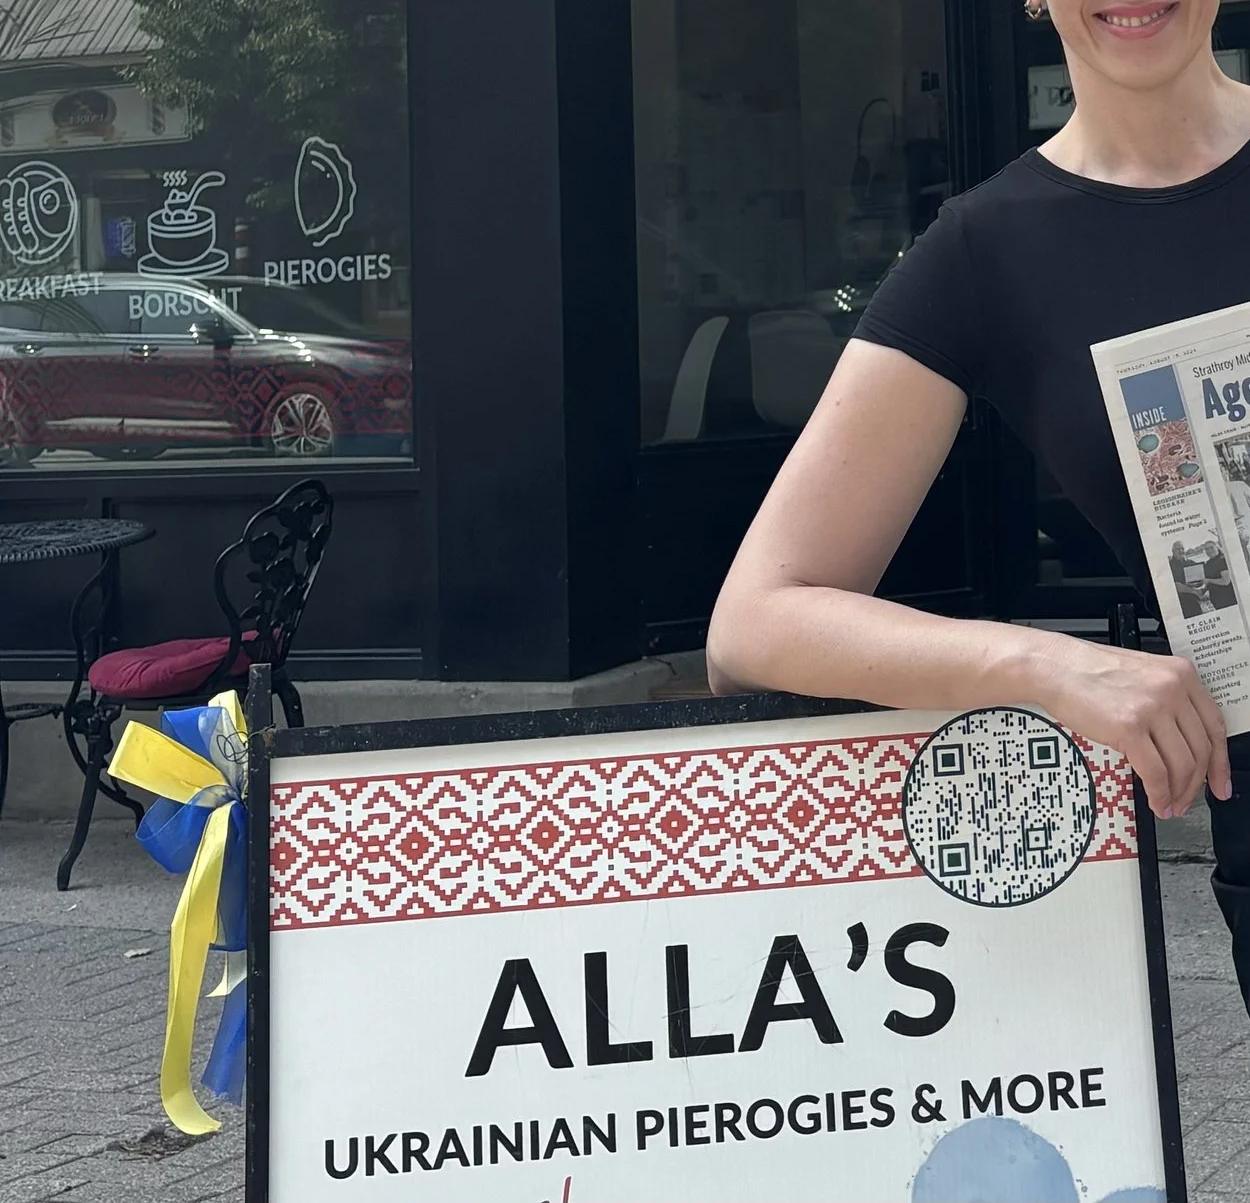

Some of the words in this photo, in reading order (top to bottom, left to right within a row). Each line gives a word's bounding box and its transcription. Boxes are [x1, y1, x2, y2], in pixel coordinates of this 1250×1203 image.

[264, 253, 392, 286] PIEROGIES
[1192, 358, 1234, 378] Strathroy
[1132, 405, 1168, 429] INSIDE
[464, 922, 956, 1077] ALLA'S
[324, 1113, 617, 1179] UKRAINIAN
[636, 1087, 894, 1150] PIEROGIES
[911, 1082, 945, 1123] &
[960, 1067, 1107, 1118] MORE
